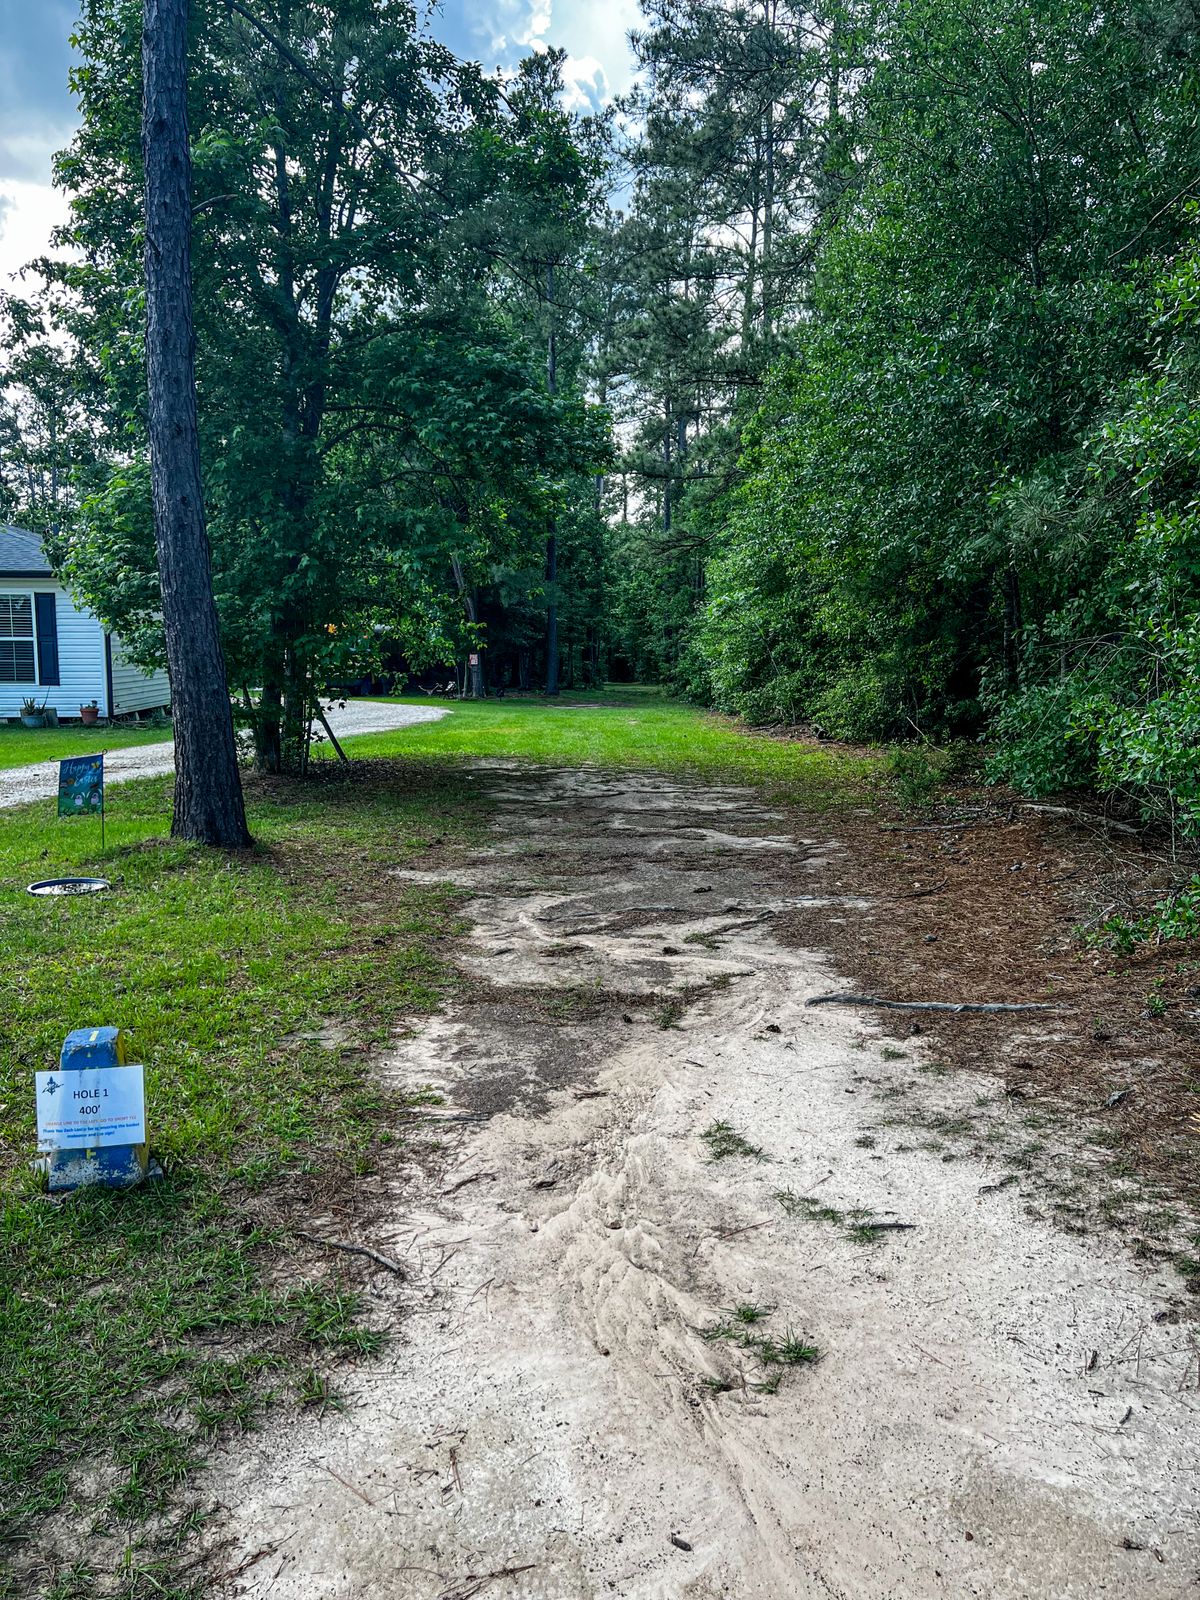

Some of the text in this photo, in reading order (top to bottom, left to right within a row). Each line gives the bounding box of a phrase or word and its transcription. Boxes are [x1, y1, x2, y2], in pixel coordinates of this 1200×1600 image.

[62, 761, 90, 776] Happy
[73, 1088, 109, 1099] HOLE 1
